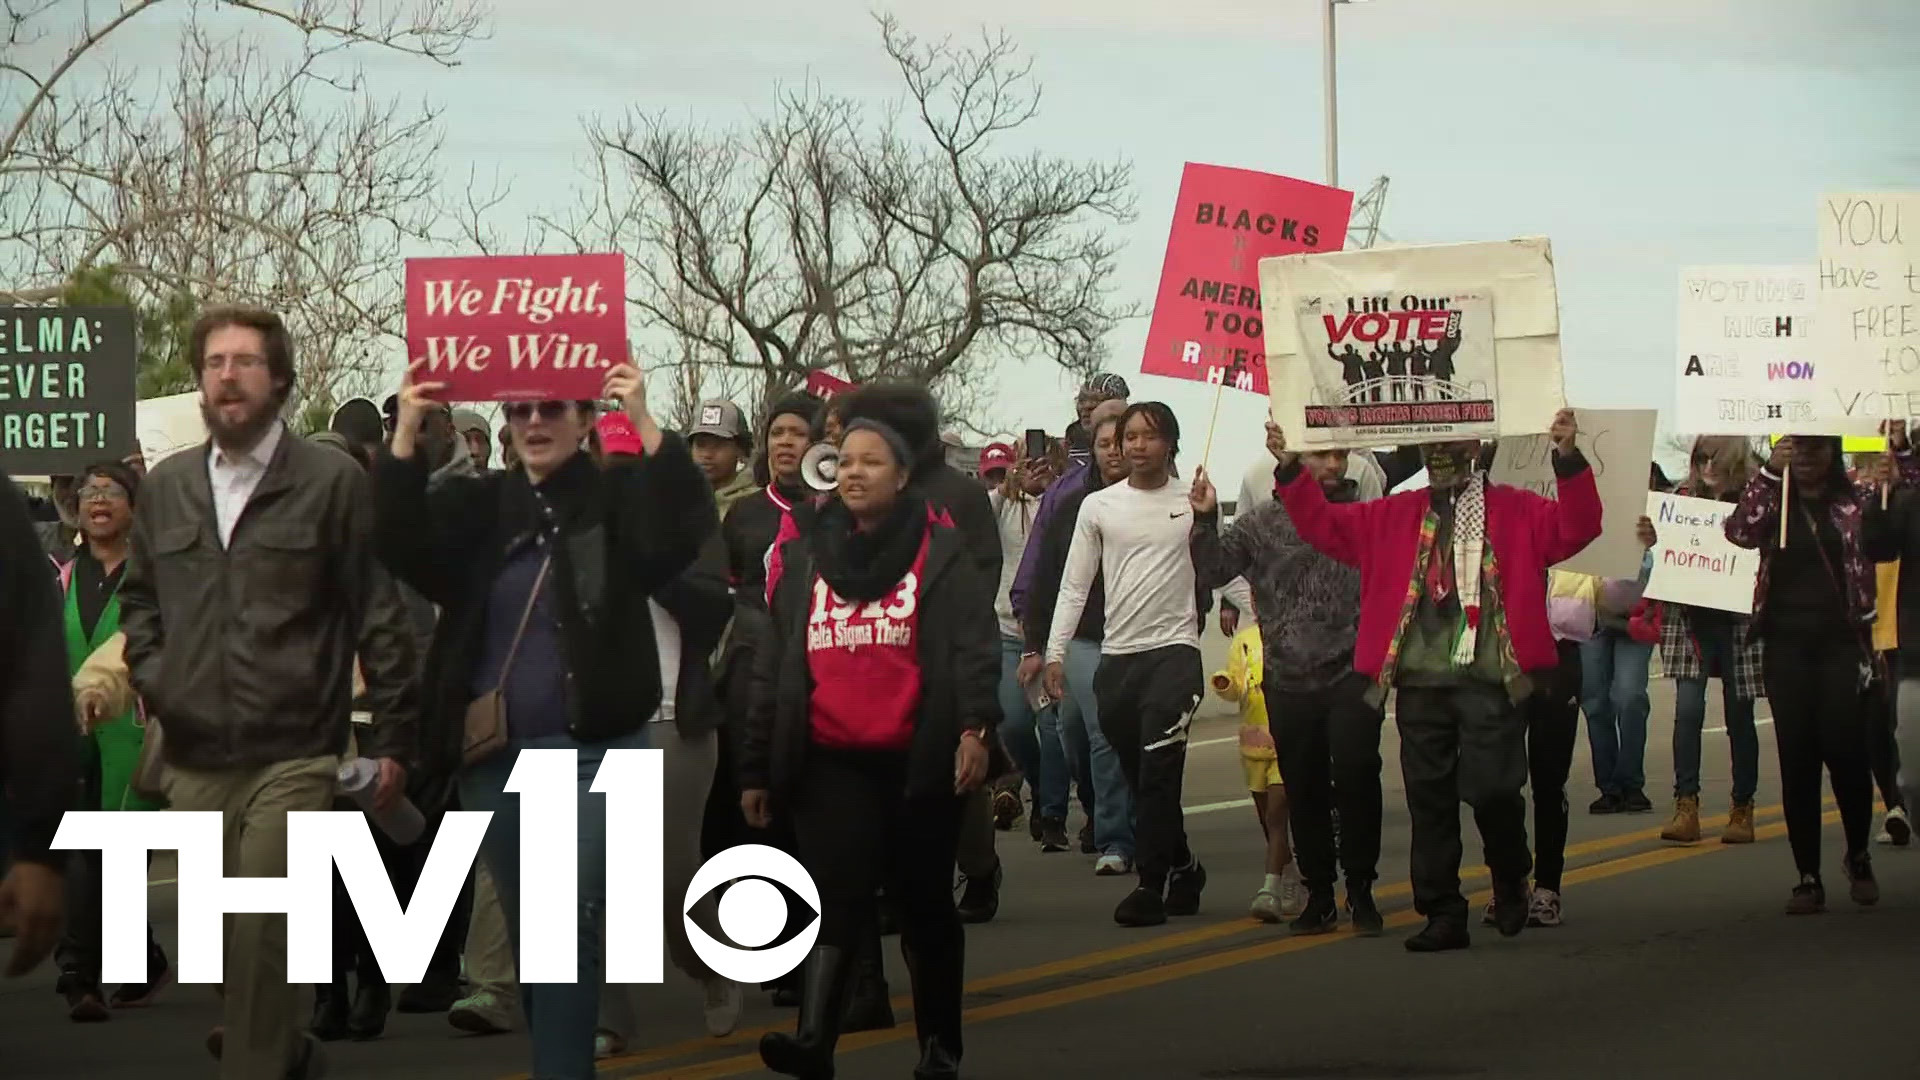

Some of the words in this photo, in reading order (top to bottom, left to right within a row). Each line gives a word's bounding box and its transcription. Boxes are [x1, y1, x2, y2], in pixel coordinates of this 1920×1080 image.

[1196, 202, 1319, 247] BLACKS
[1827, 198, 1903, 246] YOU
[1686, 277, 1807, 302] VOTING
[1819, 259, 1880, 291] Have
[424, 279, 483, 316] We
[488, 276, 608, 324] Fight,
[1347, 297, 1389, 314] Lift
[1400, 294, 1450, 312] Our
[1204, 310, 1263, 339] TOO
[1323, 310, 1451, 344] VOTE
[426, 335, 492, 373] We
[507, 332, 612, 370] Win.
[1684, 352, 1741, 378] ARE
[1718, 398, 1817, 422] RIGHTS
[1834, 387, 1920, 416] VOTE
[4, 412, 106, 449] RGET!
[1659, 499, 1700, 526] None
[1703, 512, 1717, 528] of
[1690, 533, 1700, 546] is
[835, 618, 873, 653] Sigma
[875, 616, 911, 647] Theta
